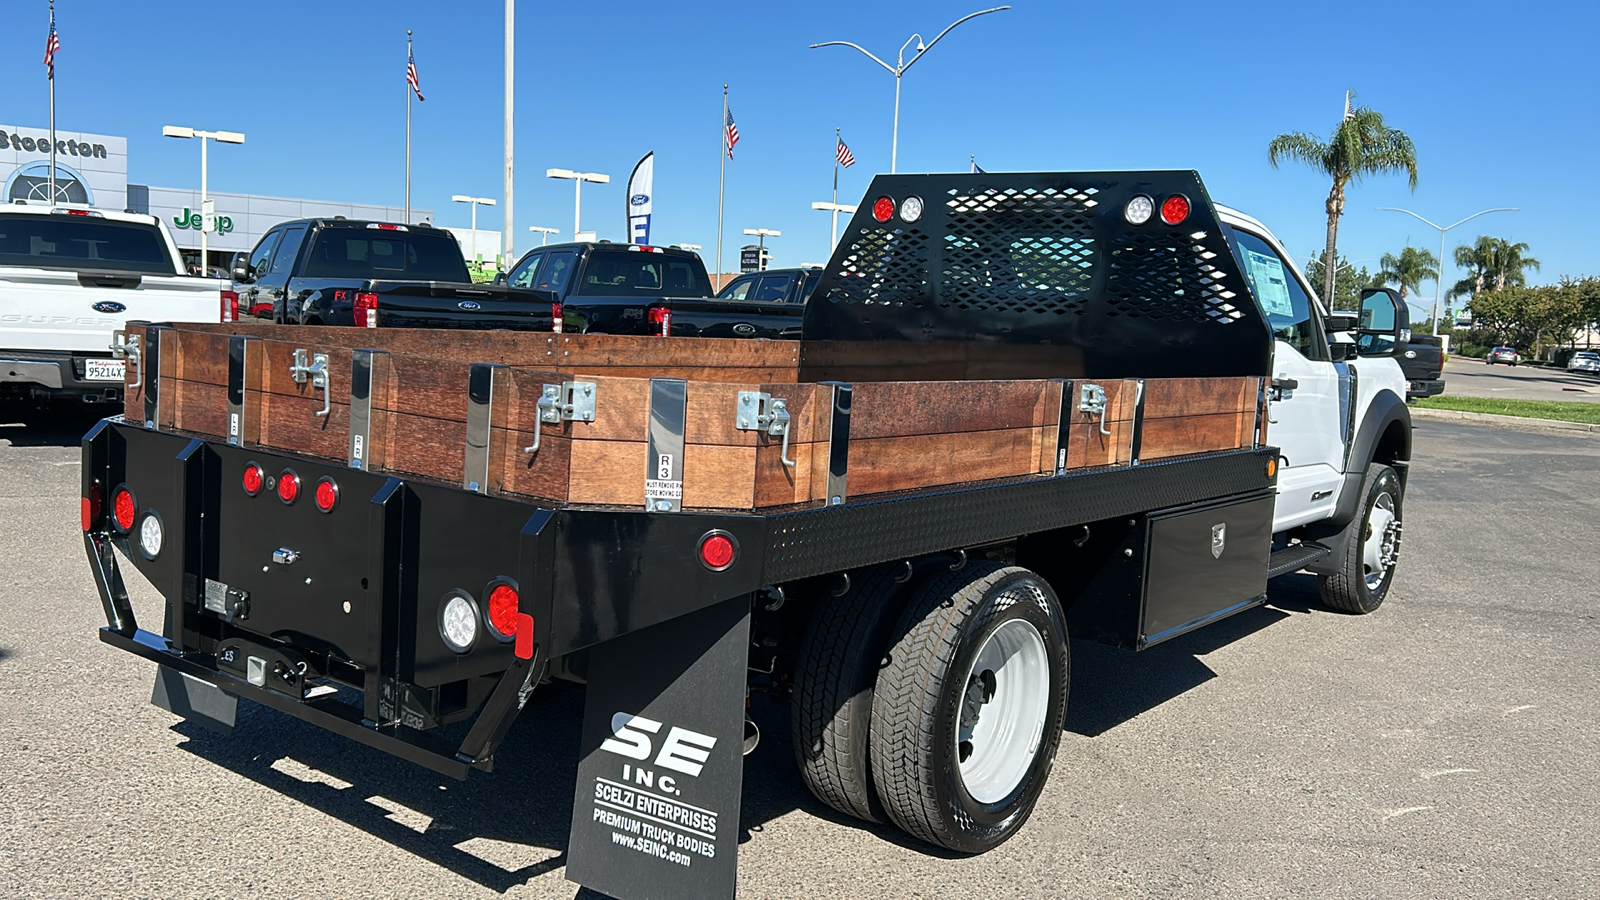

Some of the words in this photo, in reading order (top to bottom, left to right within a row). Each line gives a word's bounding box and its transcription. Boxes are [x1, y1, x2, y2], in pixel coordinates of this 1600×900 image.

[0, 130, 107, 159] Stockton
[173, 207, 233, 234] Jep
[1, 314, 118, 327] SUPER
[661, 455, 669, 466] R
[661, 468, 669, 478] 3
[600, 711, 717, 777] SE
[622, 764, 681, 796] INC.
[595, 783, 635, 808] SCELZI
[636, 794, 717, 833] ENTERPRISES
[593, 808, 641, 835] PREMIUM
[641, 822, 676, 846] TRUCK
[676, 833, 715, 858] BODIES
[612, 832, 691, 867] www.SEINC.com
